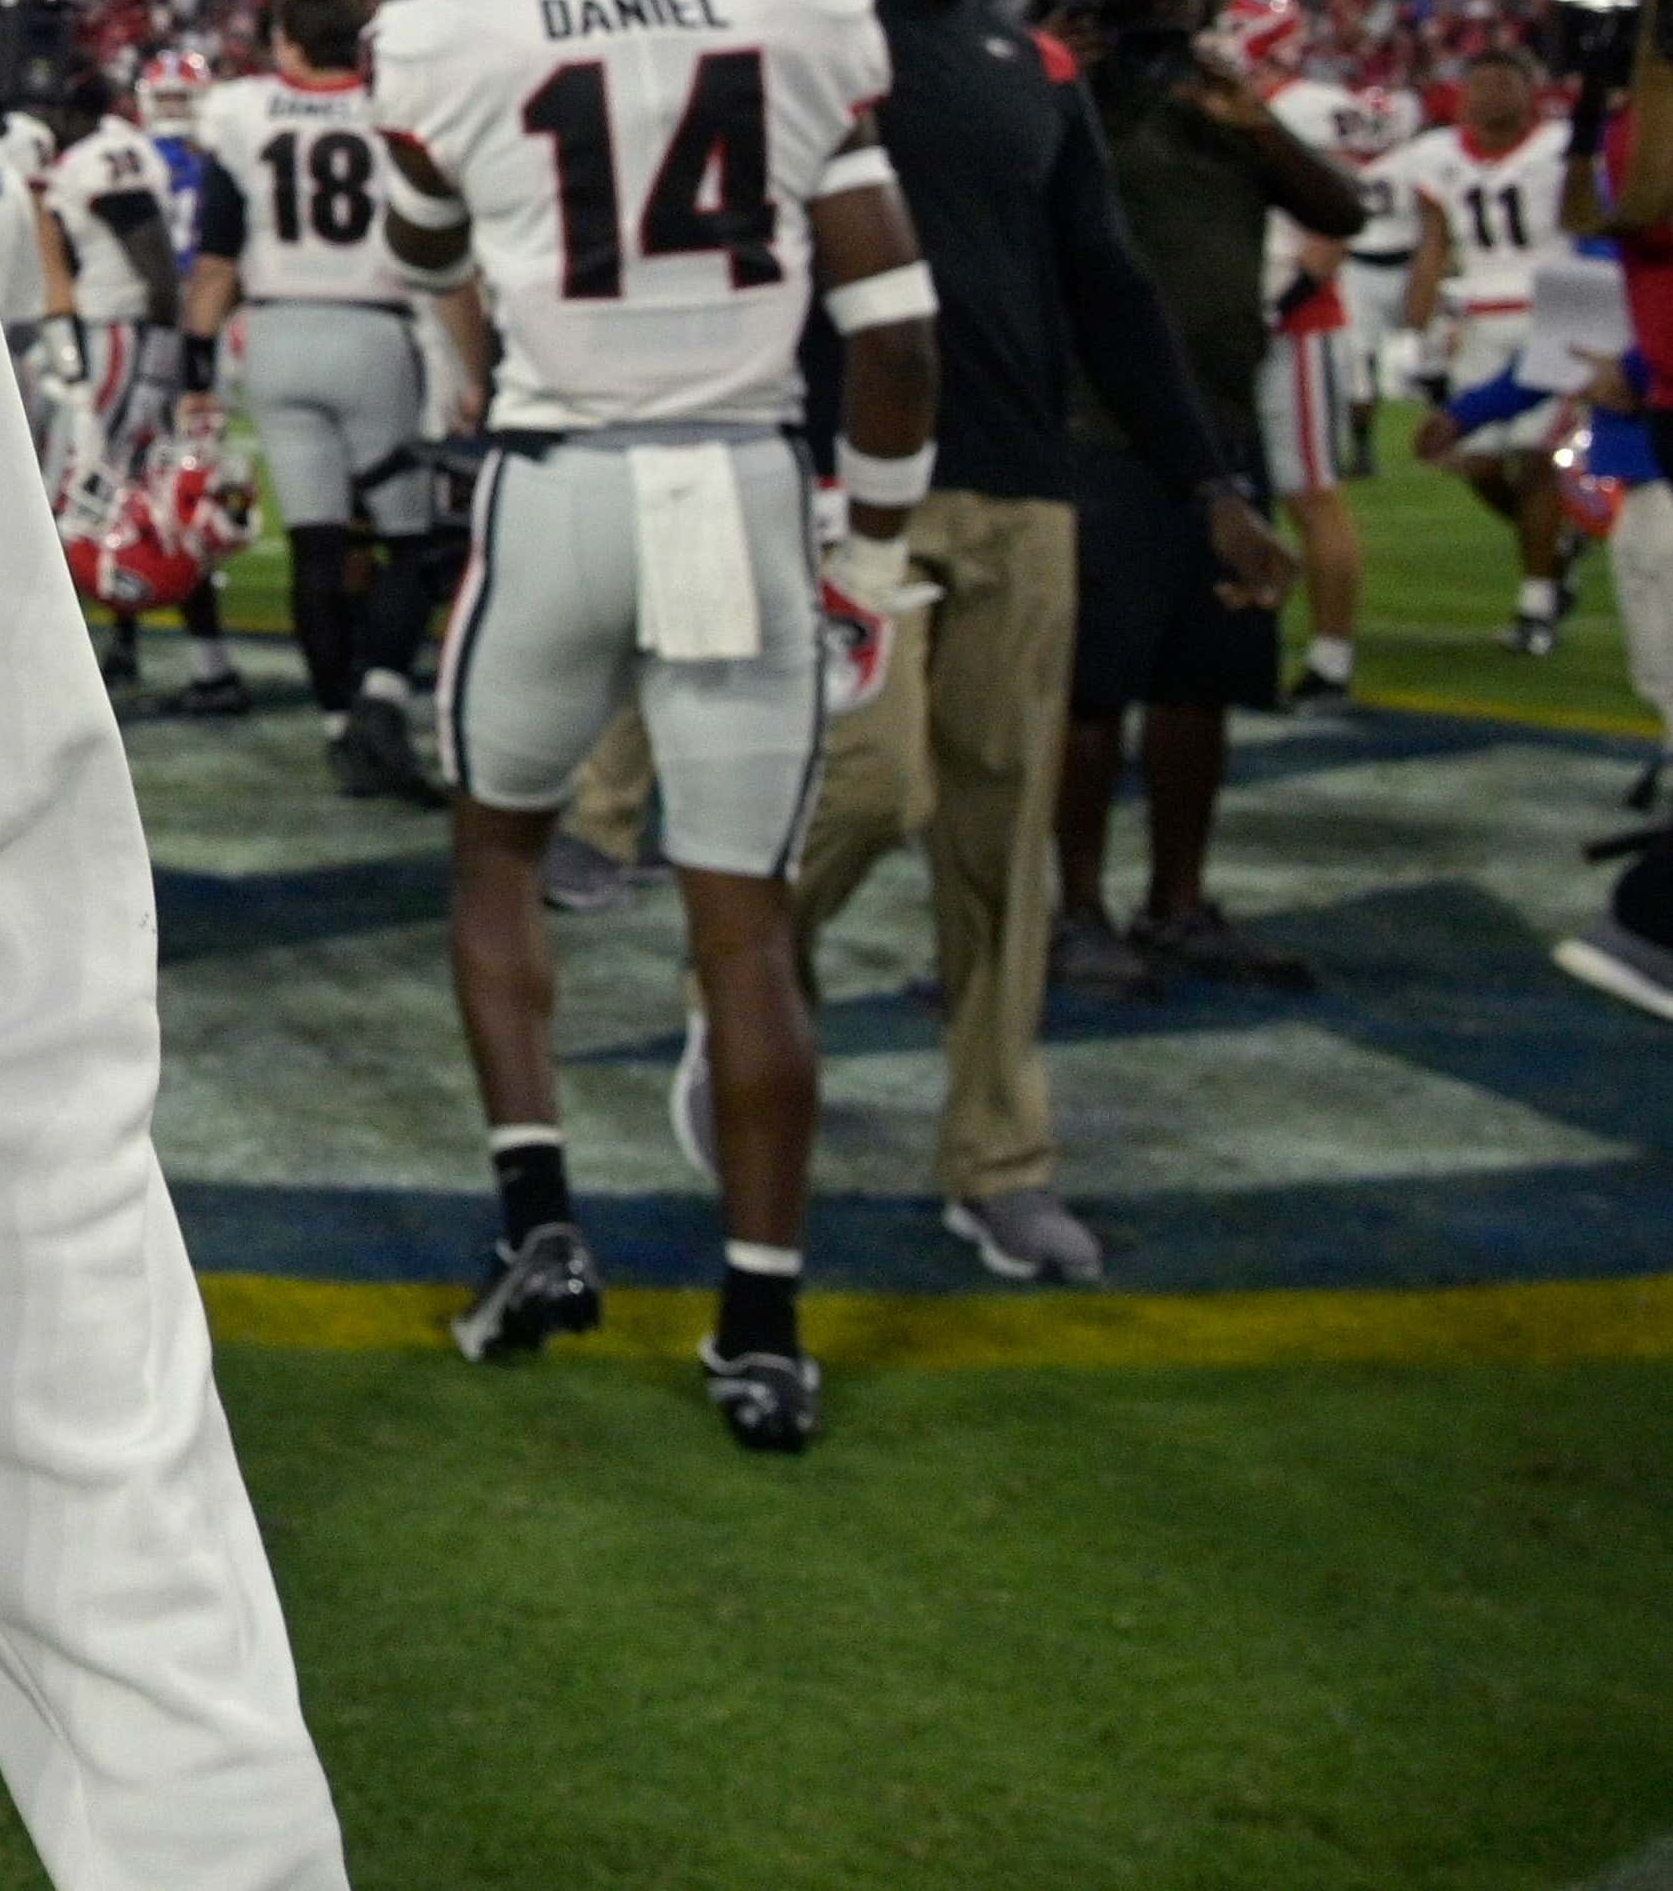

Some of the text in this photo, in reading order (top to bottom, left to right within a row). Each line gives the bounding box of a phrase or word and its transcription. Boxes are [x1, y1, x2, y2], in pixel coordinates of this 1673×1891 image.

[258, 129, 376, 246] 18
[521, 44, 787, 301] 14
[1464, 179, 1529, 249] 11
